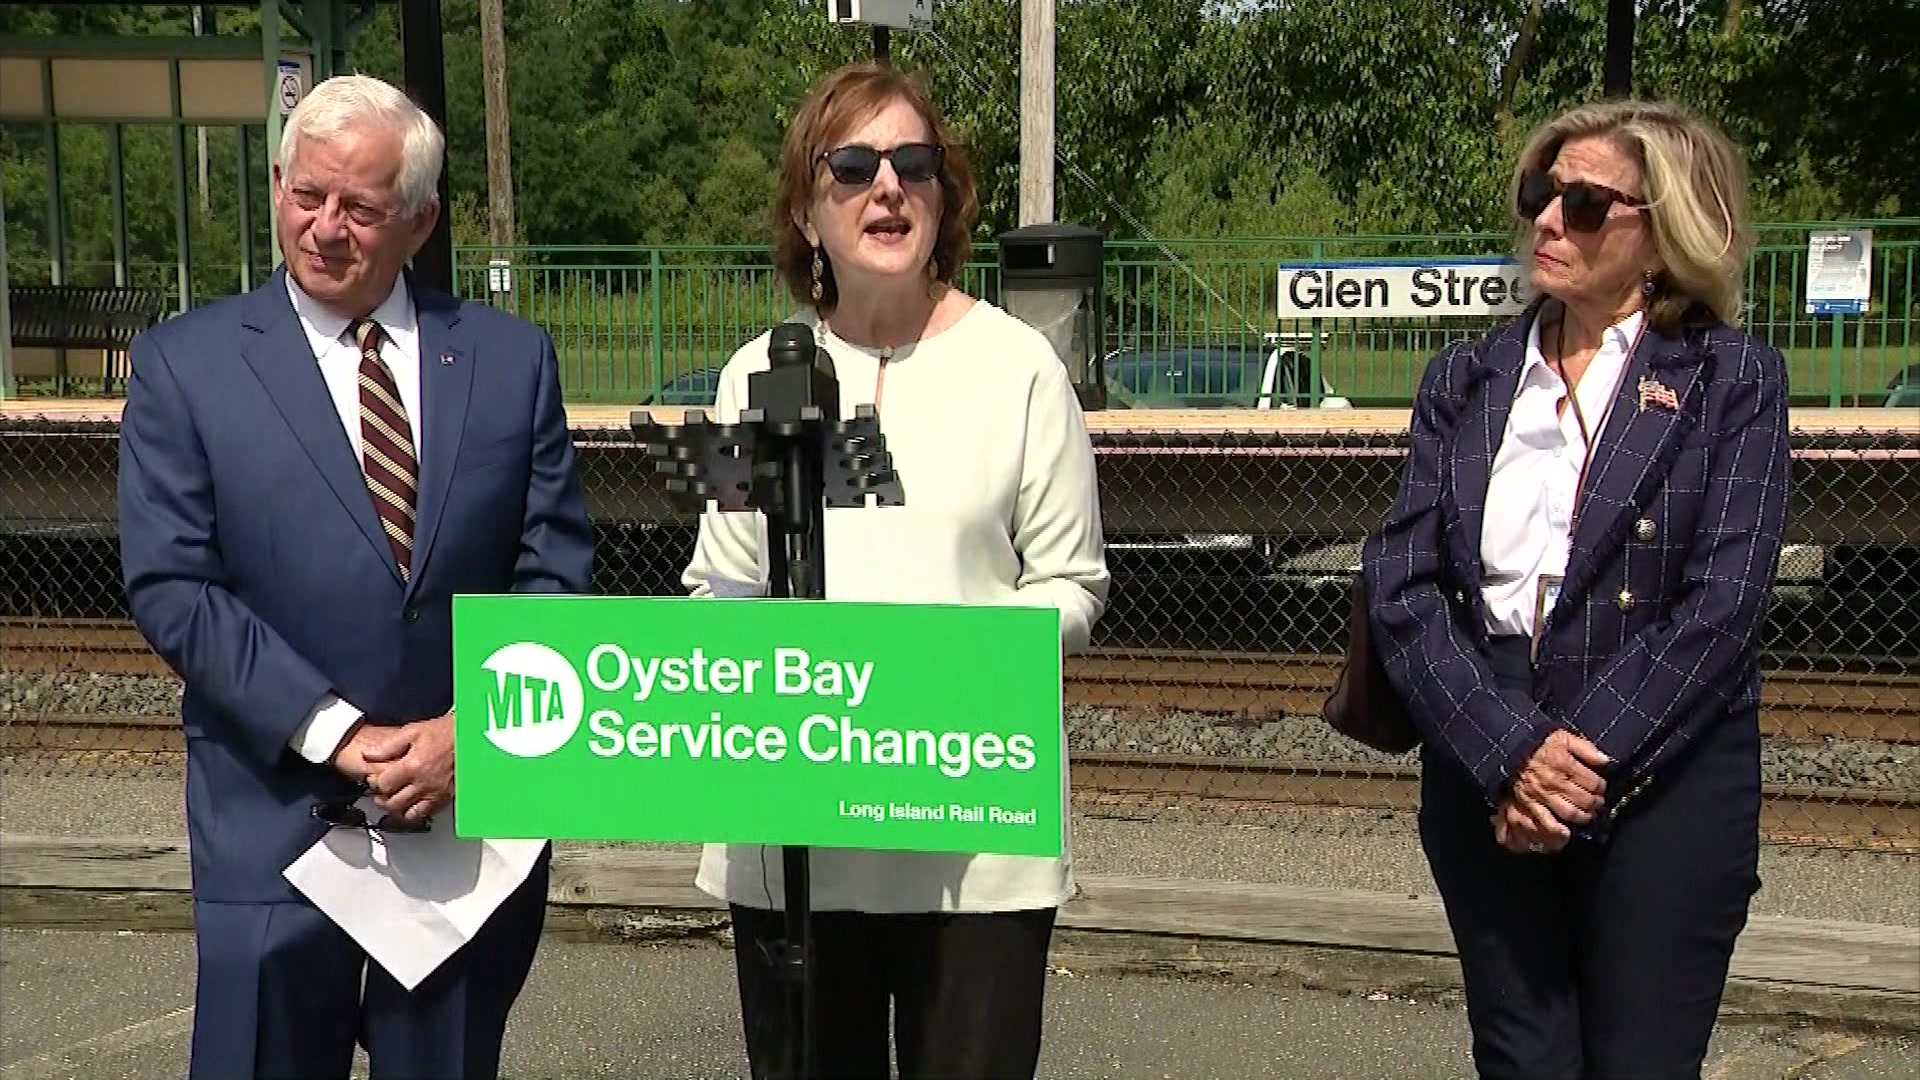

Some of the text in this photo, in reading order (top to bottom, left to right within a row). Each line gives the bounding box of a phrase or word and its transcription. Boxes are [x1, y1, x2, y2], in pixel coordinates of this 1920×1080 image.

[1289, 268, 1525, 309] Glen Stree
[480, 668, 565, 731] MTA
[586, 643, 875, 708] Oyster Bay
[588, 709, 1036, 778] Service Changes
[839, 800, 1037, 825] Long Island Rail Road
